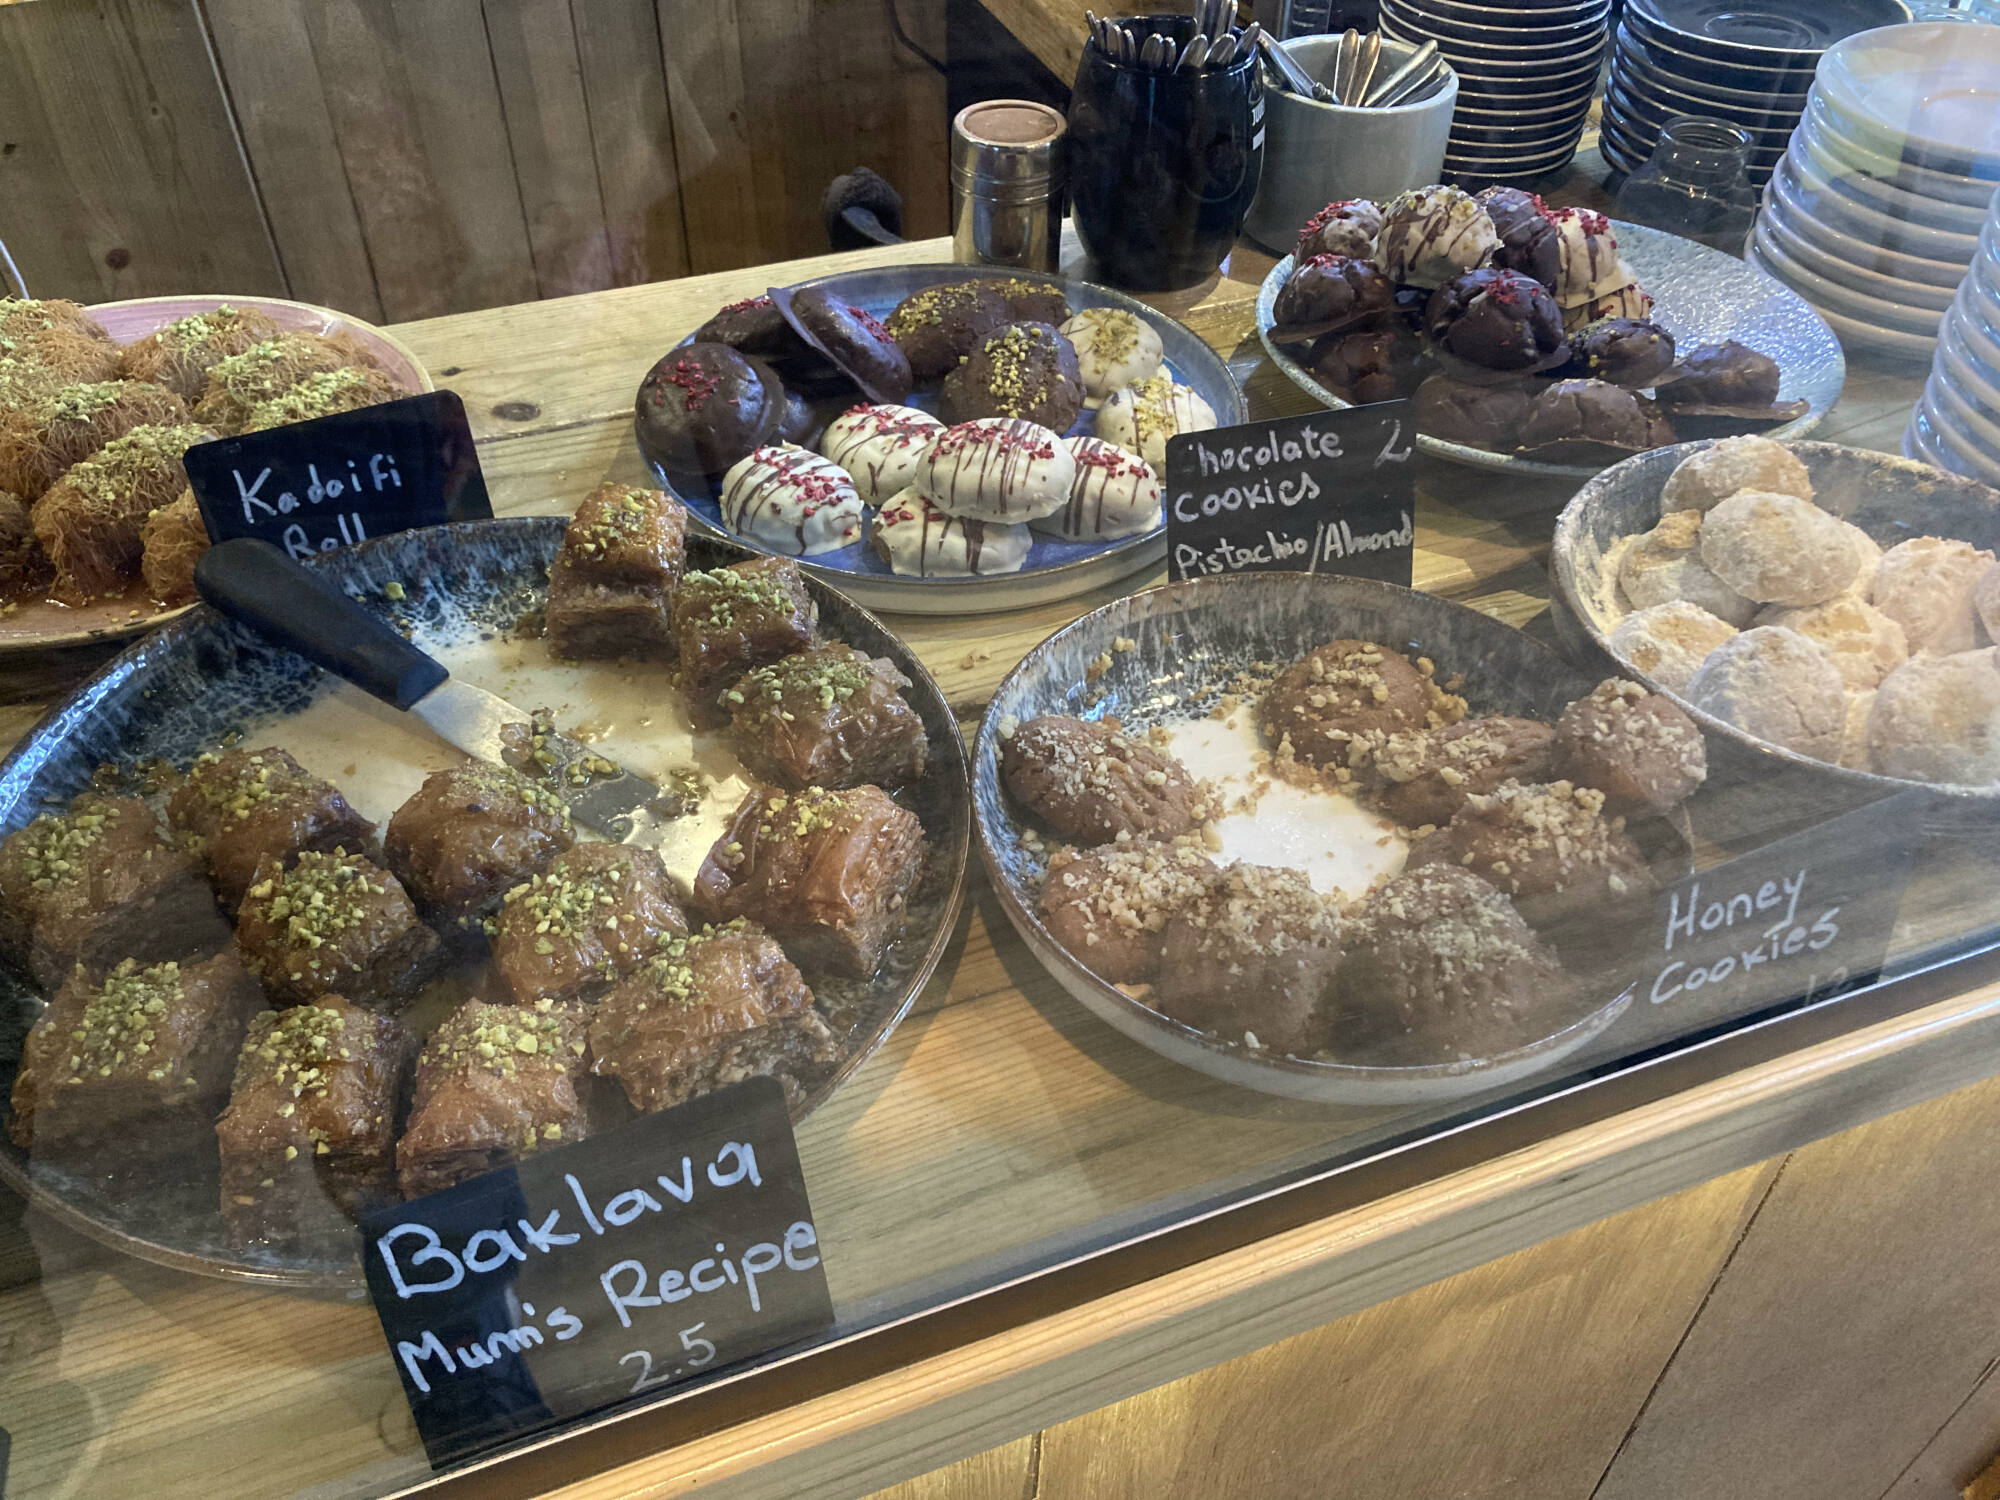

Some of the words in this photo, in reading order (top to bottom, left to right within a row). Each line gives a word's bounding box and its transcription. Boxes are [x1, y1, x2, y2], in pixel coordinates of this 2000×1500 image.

[1185, 424, 1344, 477] hocolate
[1373, 418, 1412, 470] 2
[1664, 869, 1806, 950] Honey
[1650, 906, 1840, 1005] Cookies
[377, 1141, 762, 1299] Baklava
[600, 1220, 820, 1328] Recipe
[619, 1322, 717, 1393] 2.5
